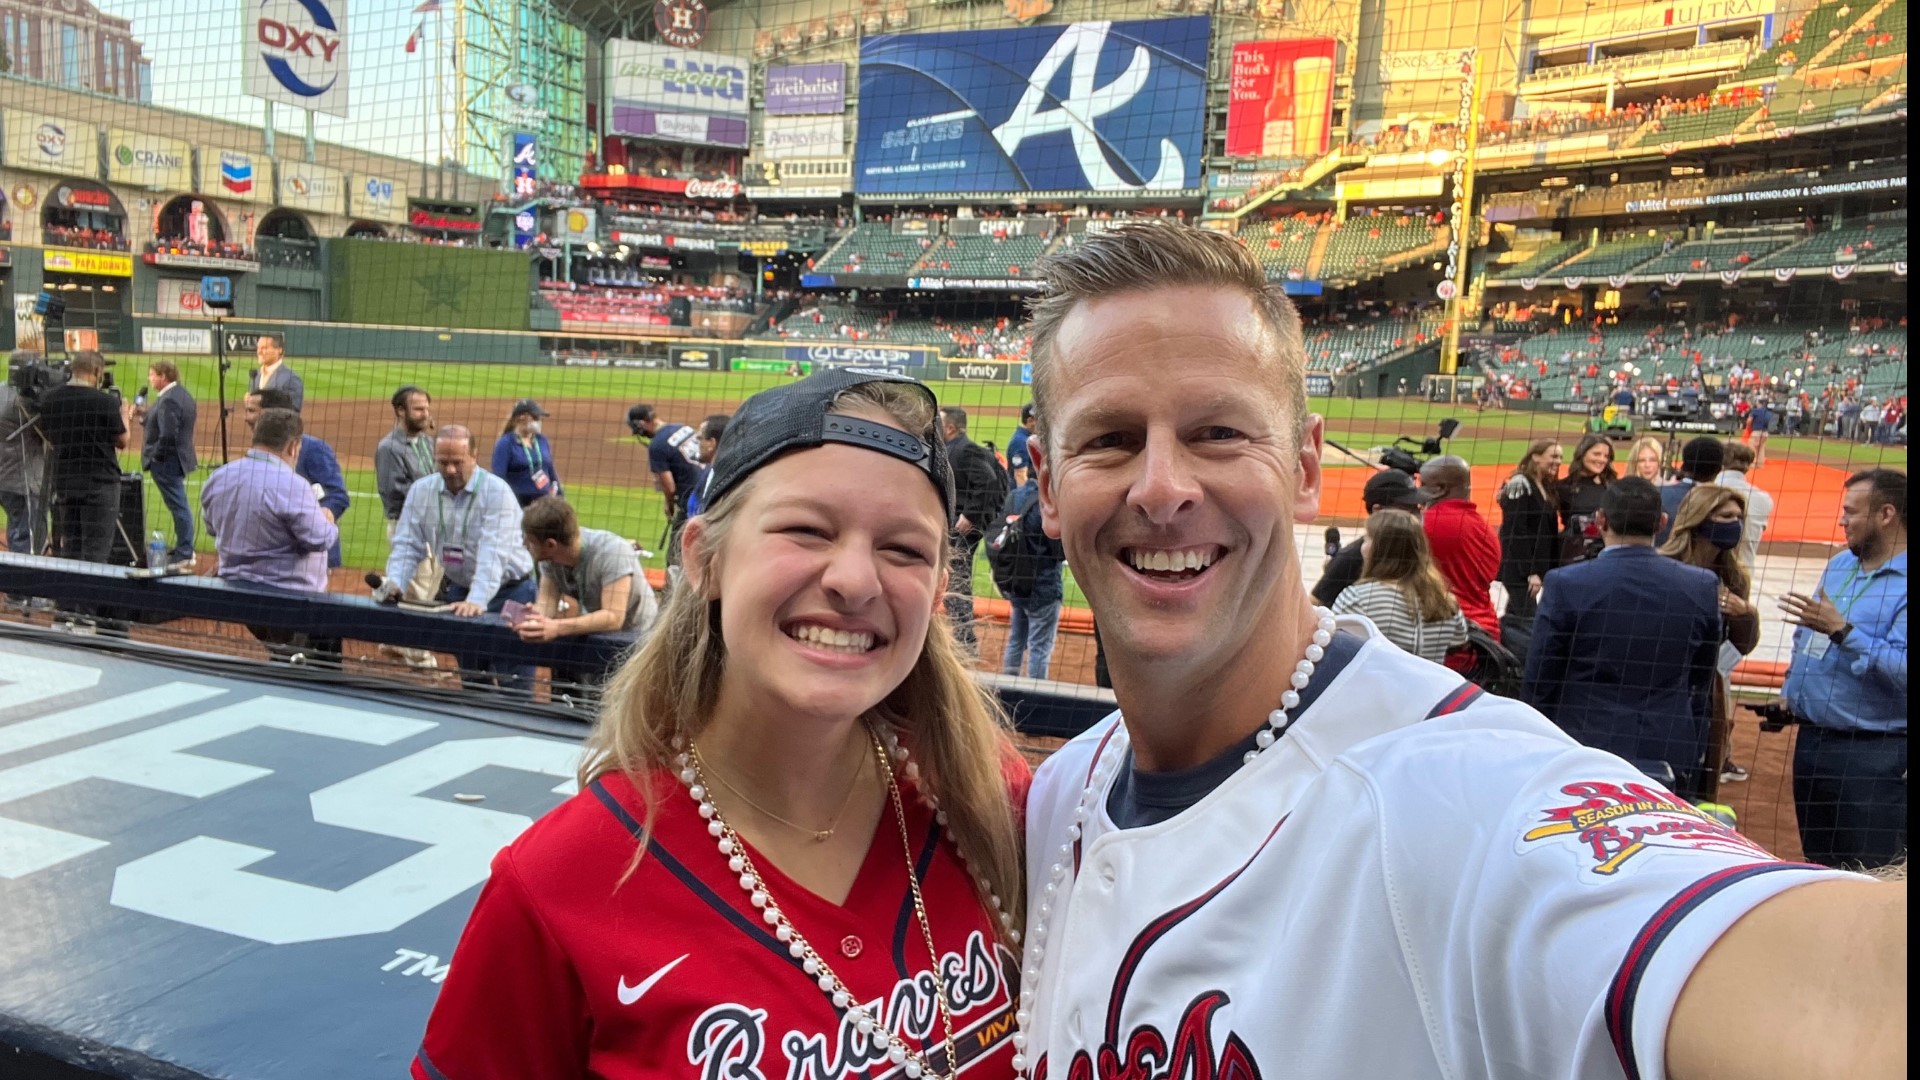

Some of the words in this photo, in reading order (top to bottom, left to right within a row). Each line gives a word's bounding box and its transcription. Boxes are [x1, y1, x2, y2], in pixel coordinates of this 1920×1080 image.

[1679, 0, 1755, 24] ULTRA
[258, 17, 341, 63] OXY
[1234, 51, 1264, 63] This
[621, 62, 730, 89] FREEPORT
[663, 57, 744, 101] LNG
[1234, 64, 1270, 76] Bud's
[1234, 77, 1255, 88] For
[1232, 89, 1261, 101] You.
[36, 133, 65, 146] OXY
[881, 120, 964, 149] BRAVES
[135, 150, 182, 168] CRANE
[1639, 197, 1667, 211] Mitel
[1670, 197, 1704, 206] OFFICIAL
[1706, 193, 1743, 205] BUSINESS
[1745, 188, 1801, 201] TECHNOLOGY
[1803, 187, 1809, 196] &
[1811, 178, 1888, 195] COMMUNICATIONS
[979, 220, 1025, 240] CHEVY
[958, 362, 998, 379] xfinity
[1577, 803, 1634, 829] SEASON
[1636, 802, 1653, 811] IN
[380, 947, 451, 984] TM
[687, 929, 1001, 1080] Braves
